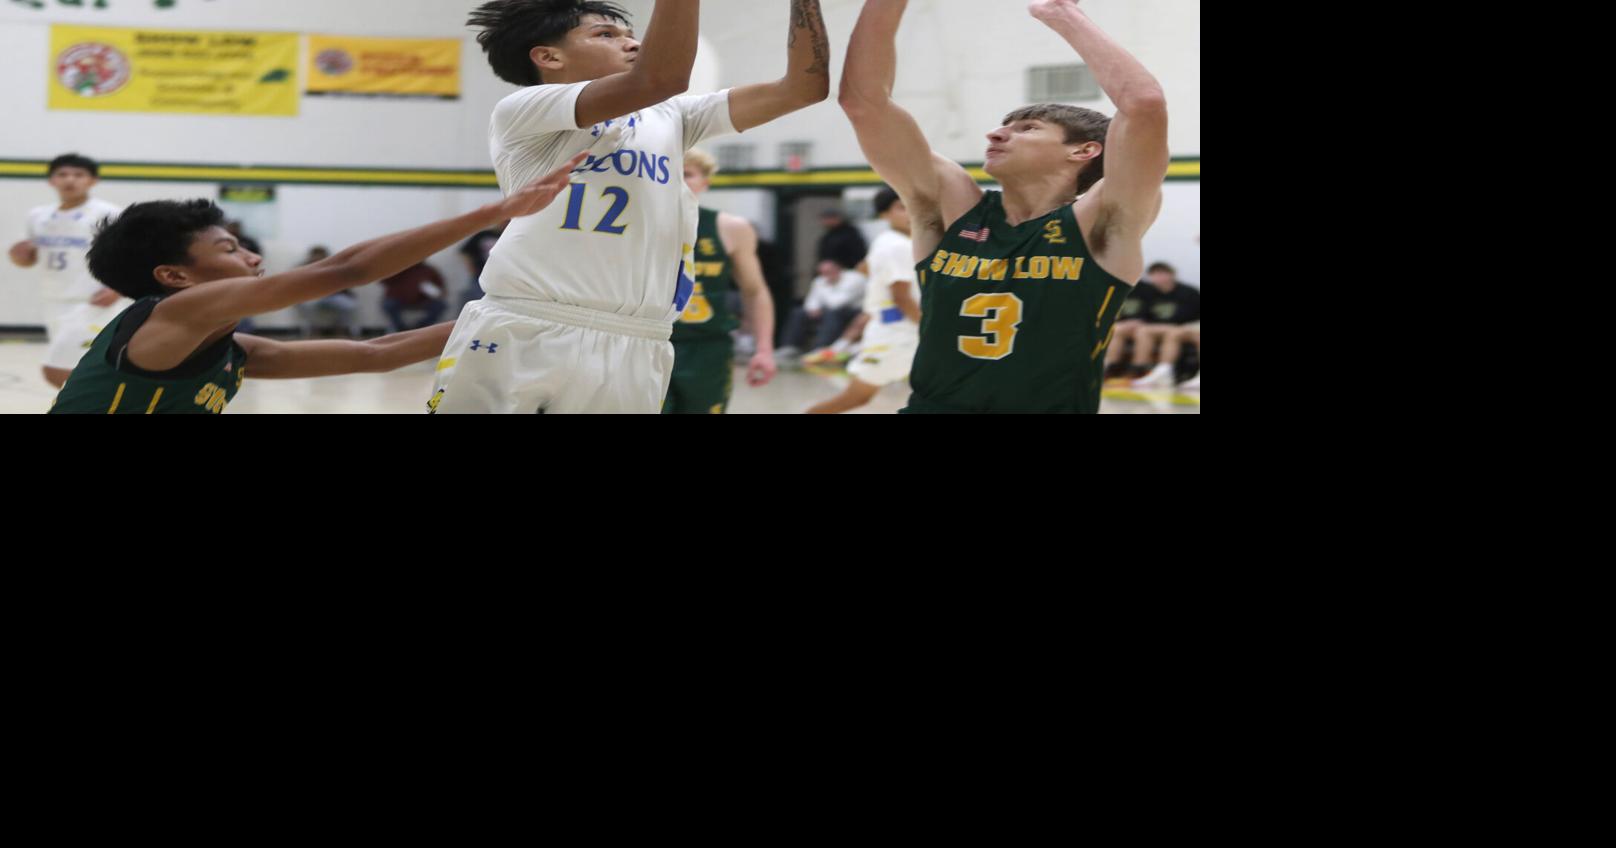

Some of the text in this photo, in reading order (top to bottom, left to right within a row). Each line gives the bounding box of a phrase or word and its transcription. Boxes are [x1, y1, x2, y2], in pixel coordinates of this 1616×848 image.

[559, 181, 630, 235] 12
[929, 249, 1085, 281] SHOW LOW
[957, 291, 1024, 361] 3
